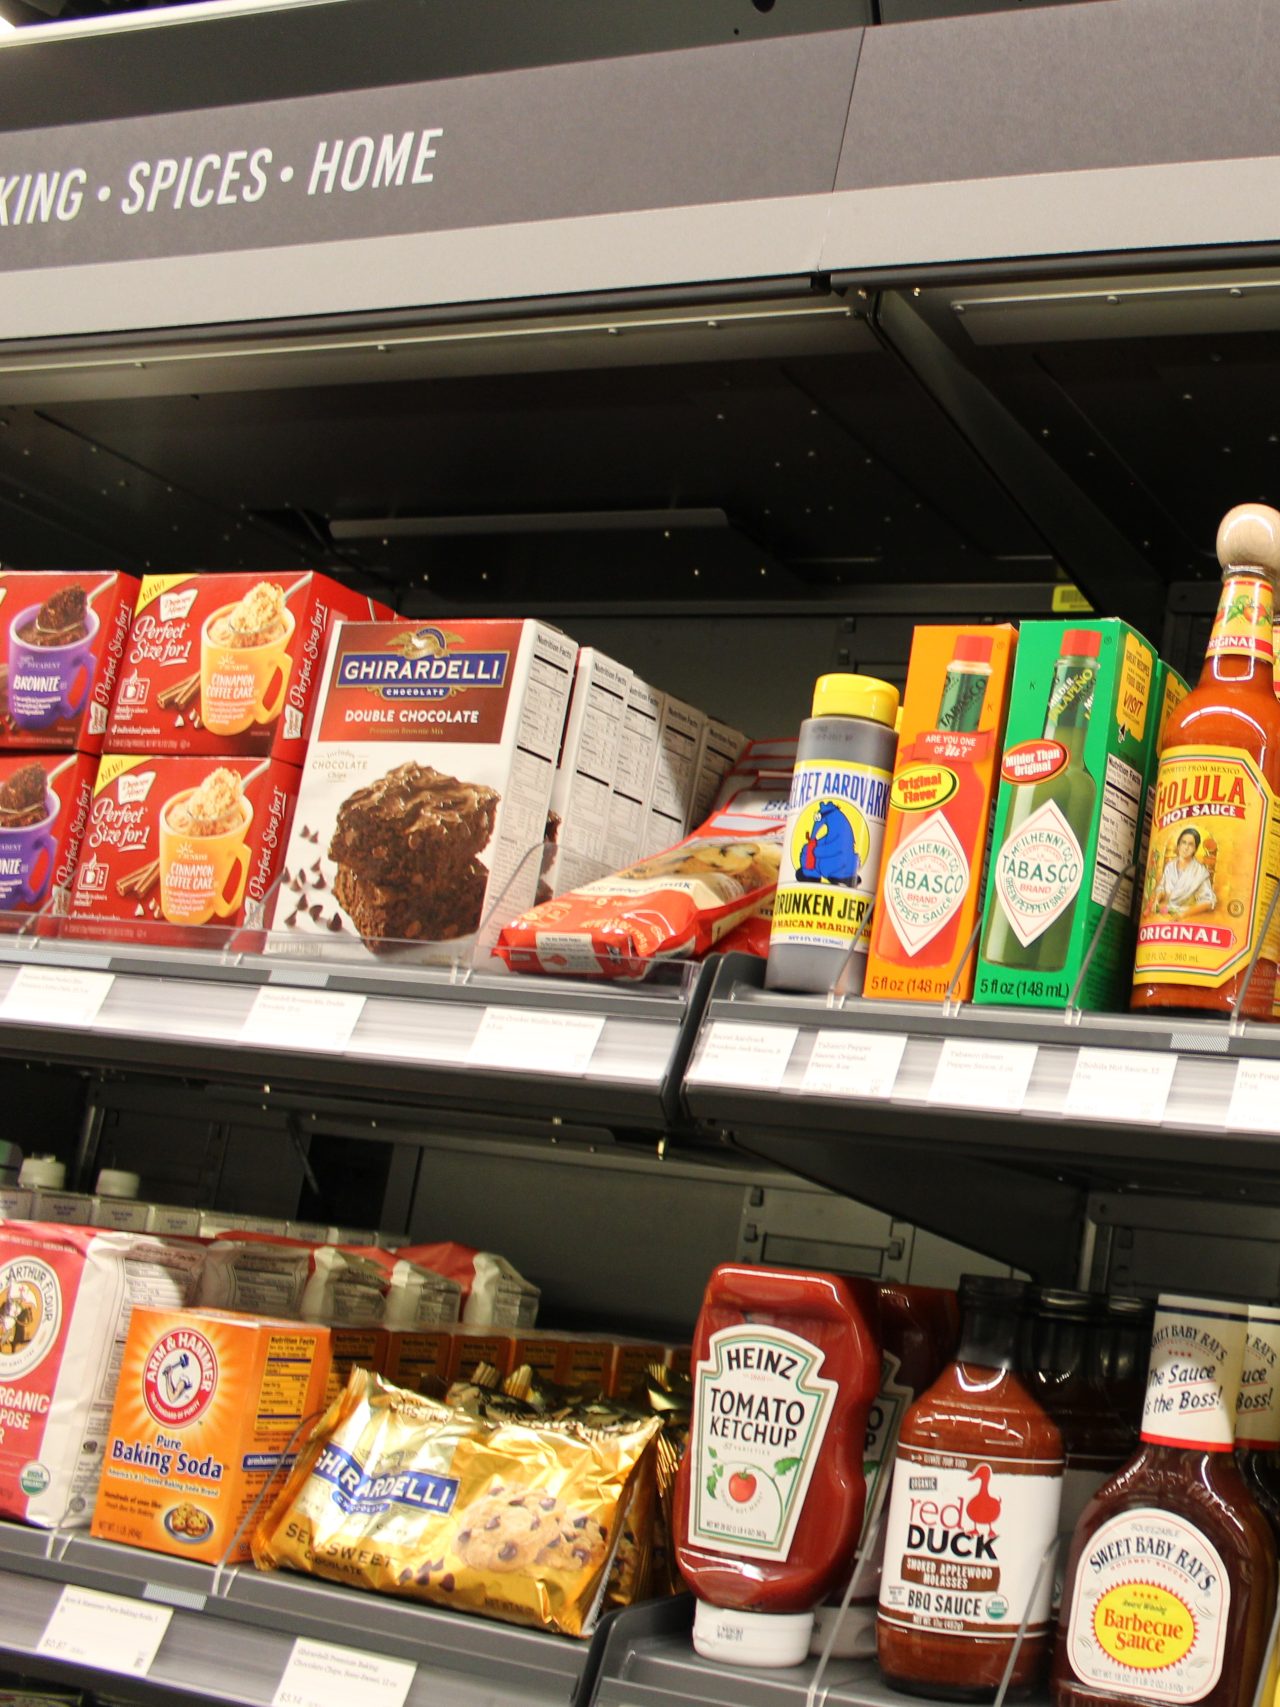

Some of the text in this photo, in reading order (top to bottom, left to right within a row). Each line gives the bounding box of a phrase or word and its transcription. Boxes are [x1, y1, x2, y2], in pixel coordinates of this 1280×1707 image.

[121, 148, 272, 215] SPICES
[308, 128, 444, 195] HOME
[134, 616, 187, 643] Perfect
[130, 640, 161, 664] Size
[94, 657, 119, 705] Perfect
[115, 629, 125, 659] Size
[290, 657, 313, 708] Perfect
[303, 629, 321, 659] Size
[344, 659, 501, 682] GHIRARDELLI
[13, 675, 61, 693] BROWNIE
[206, 685, 255, 700] COFFEE CAKE
[211, 673, 256, 687] CINNAMON
[386, 687, 445, 697] CHOCOLATE
[344, 709, 480, 723] DOUBLE CHOCOLATE
[1123, 690, 1144, 718] VISIT
[925, 735, 976, 746] ARE YOU ONE
[934, 746, 944, 755] OF
[1005, 748, 1060, 769] Milder Than
[1014, 761, 1052, 777] Original
[898, 773, 942, 791] Original
[903, 788, 938, 804] Flavor
[1155, 775, 1246, 824] CHOLULA
[91, 797, 147, 824] Perfect
[1162, 803, 1236, 826] HOT SAUCE
[89, 824, 119, 849] Size
[890, 865, 964, 895] TABASCO
[1002, 854, 1079, 884] TABASCO
[906, 893, 938, 904] BRAND
[1016, 884, 1070, 914] PEPPER SAUCE
[1020, 883, 1051, 895] BRAND
[776, 892, 833, 917] DRUNKEN
[894, 887, 953, 923] PEPPER SAUCE
[1140, 928, 1222, 945] ORIGINAL
[871, 976, 932, 995] 5 fl oz (148
[980, 978, 1070, 999] 5 fl oz (148 mL)
[6, 1265, 54, 1322] ARTHUR FLOUR
[1171, 1325, 1229, 1363] BABY RAY'S
[147, 1332, 214, 1393] ARM & HAMMER
[726, 1346, 798, 1381] HEINZ
[1168, 1363, 1216, 1384] Sauce
[0, 1385, 50, 1414] RGANIC
[709, 1387, 805, 1427] TOMATO
[1153, 1384, 1224, 1413] the Boss!
[0, 1408, 31, 1431] POSE
[709, 1414, 797, 1449] KETCHUP
[156, 1435, 182, 1450] Pure
[112, 1440, 223, 1479] Baking Soda
[909, 1496, 965, 1531] red
[906, 1524, 1000, 1561] DUCK
[906, 1558, 993, 1580] SMOKED APPLEWOOD
[1089, 1536, 1217, 1592] SWEET BABY RAY'S
[923, 1572, 968, 1590] MOLASSES
[908, 1588, 983, 1617] BBQ SAUCE
[1103, 1607, 1184, 1640] Barbecue
[1114, 1631, 1166, 1655] Sauce
